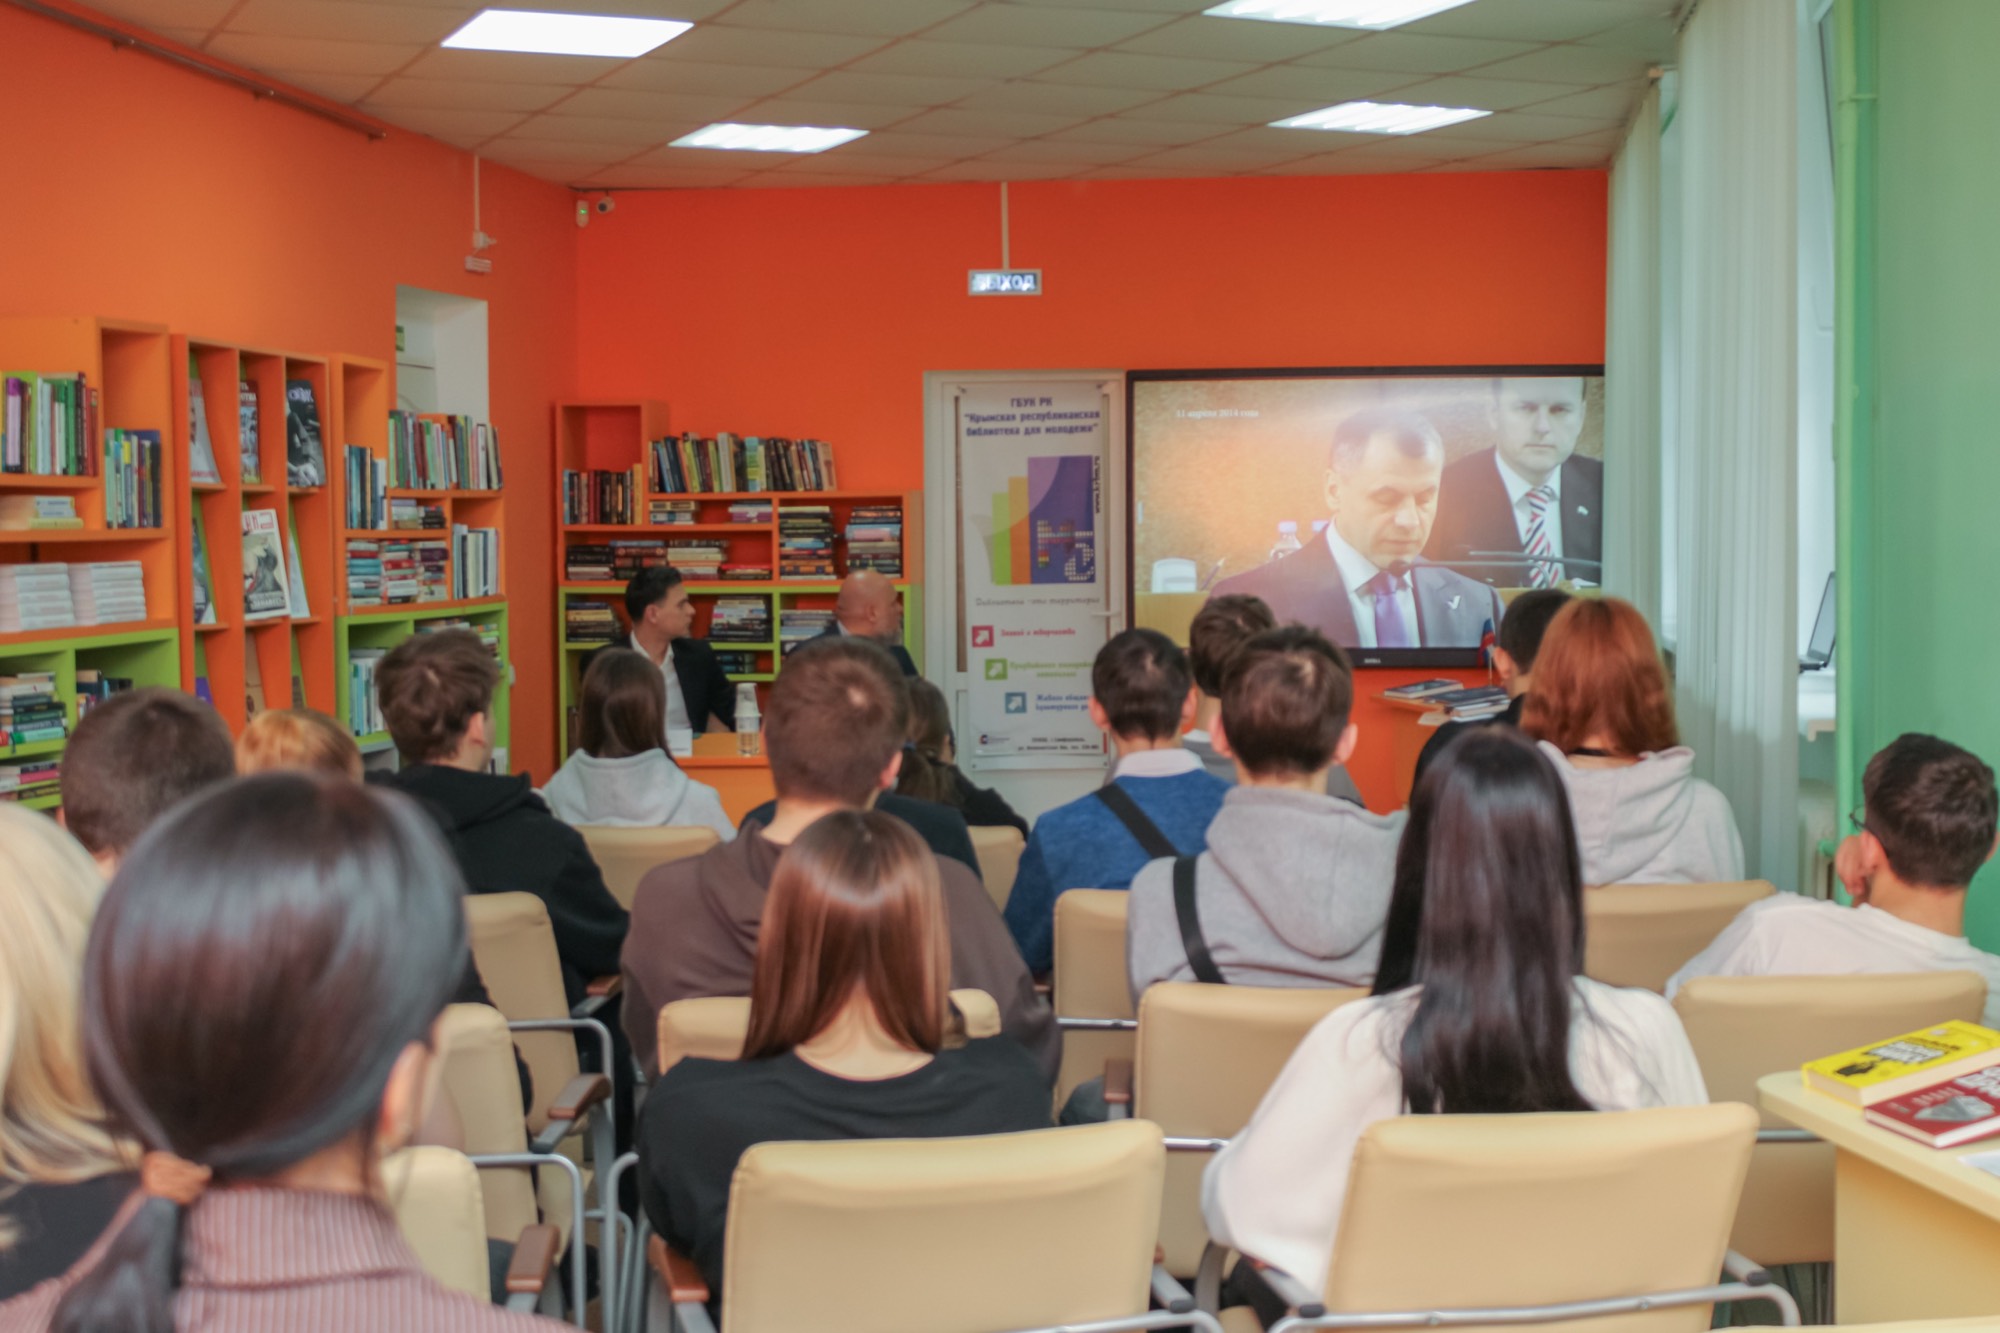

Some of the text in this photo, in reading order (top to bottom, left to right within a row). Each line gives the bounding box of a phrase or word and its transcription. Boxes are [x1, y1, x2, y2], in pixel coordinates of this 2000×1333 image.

[975, 274, 1036, 291] ВЫХОД
[1010, 397, 1053, 408] ГБУК РК
[1020, 410, 1100, 423] республиканская
[966, 426, 1020, 437] библиотека
[1024, 426, 1041, 436] для
